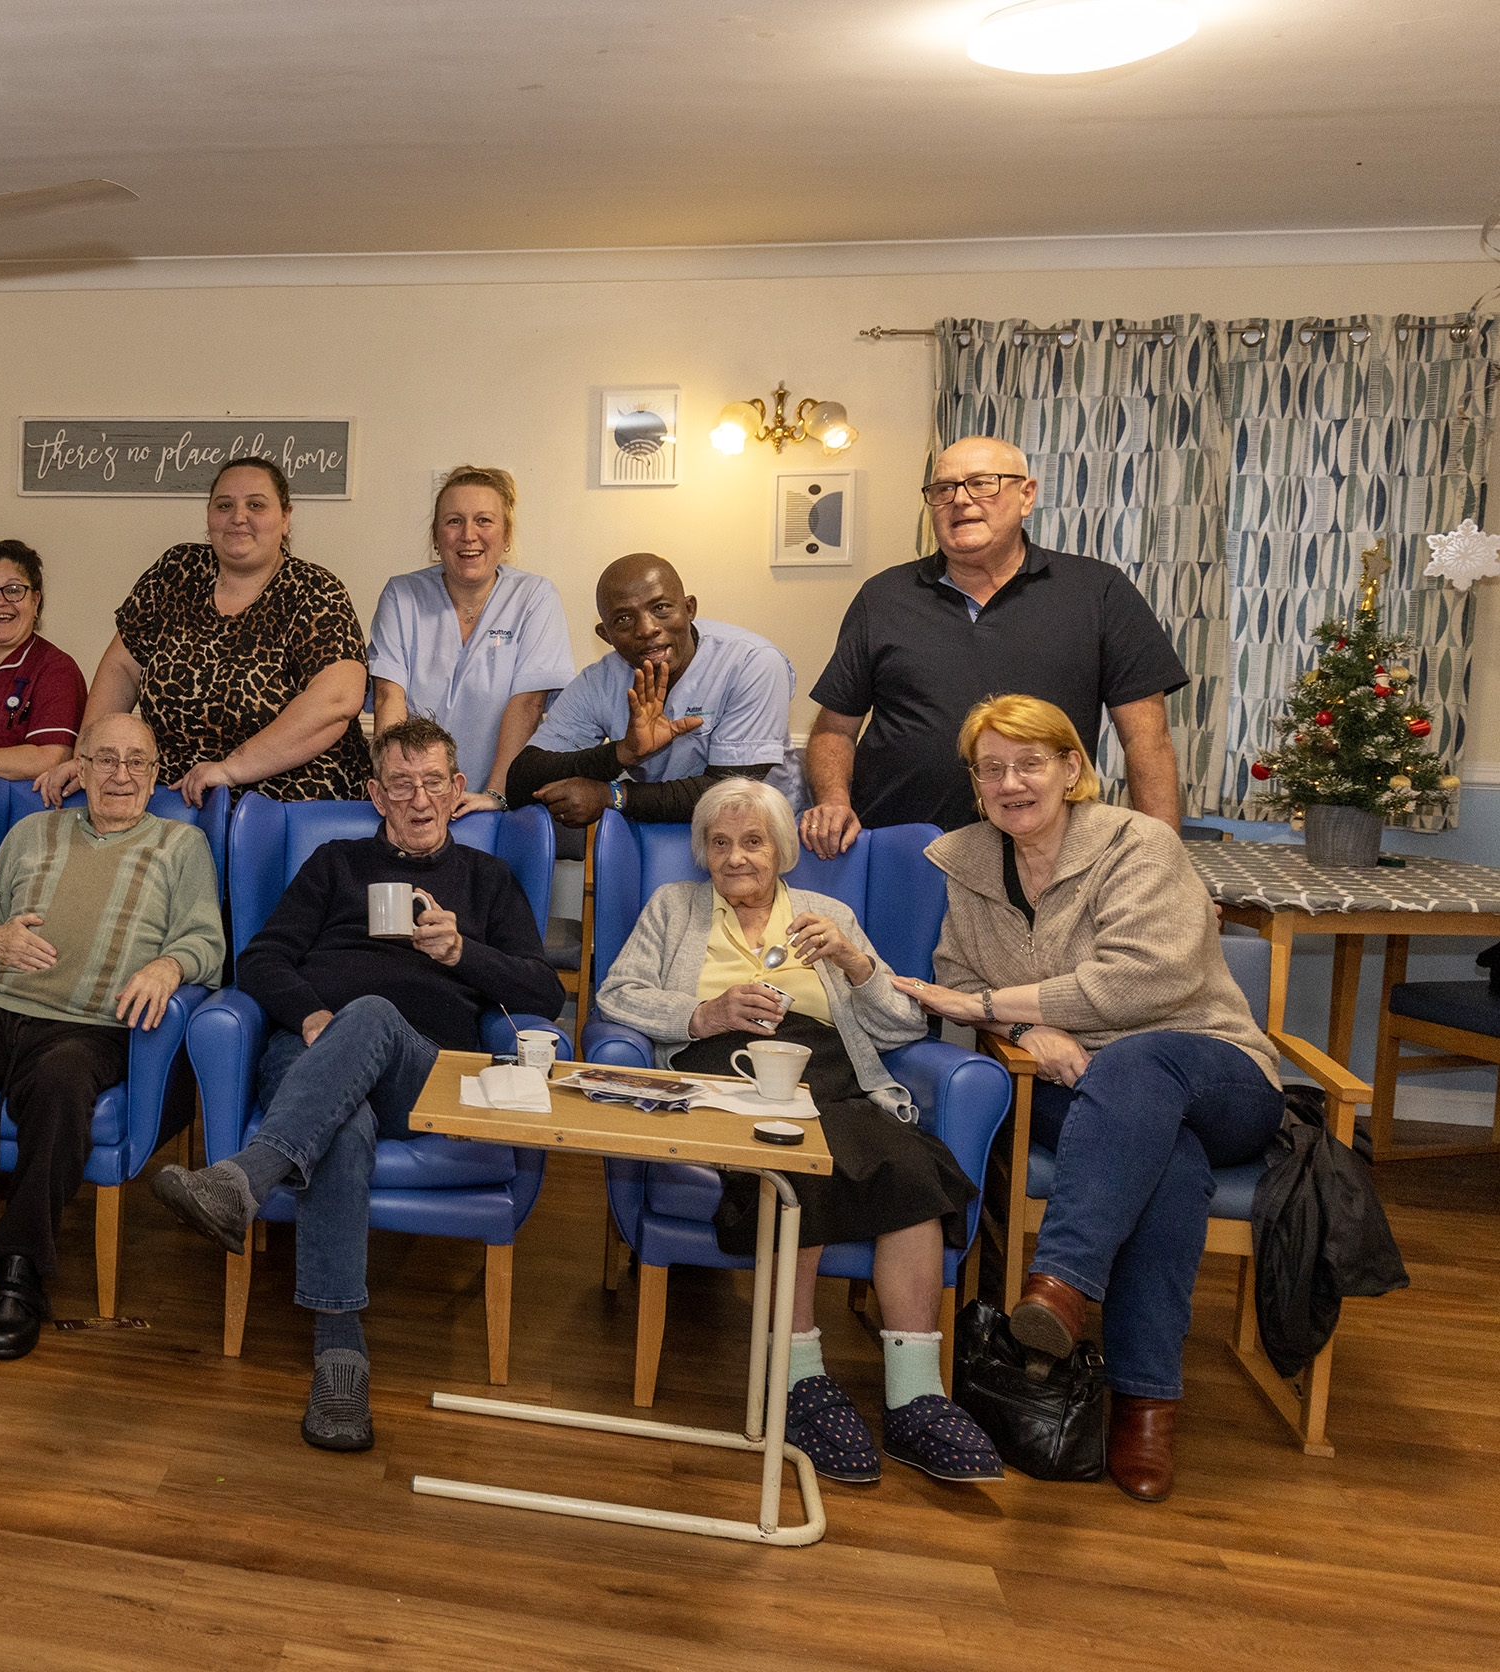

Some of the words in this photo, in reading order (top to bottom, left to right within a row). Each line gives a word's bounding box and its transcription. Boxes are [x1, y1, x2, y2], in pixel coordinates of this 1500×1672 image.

[27, 428, 119, 481] there's
[127, 446, 151, 463] no
[154, 431, 225, 483] place
[283, 435, 343, 479] home
